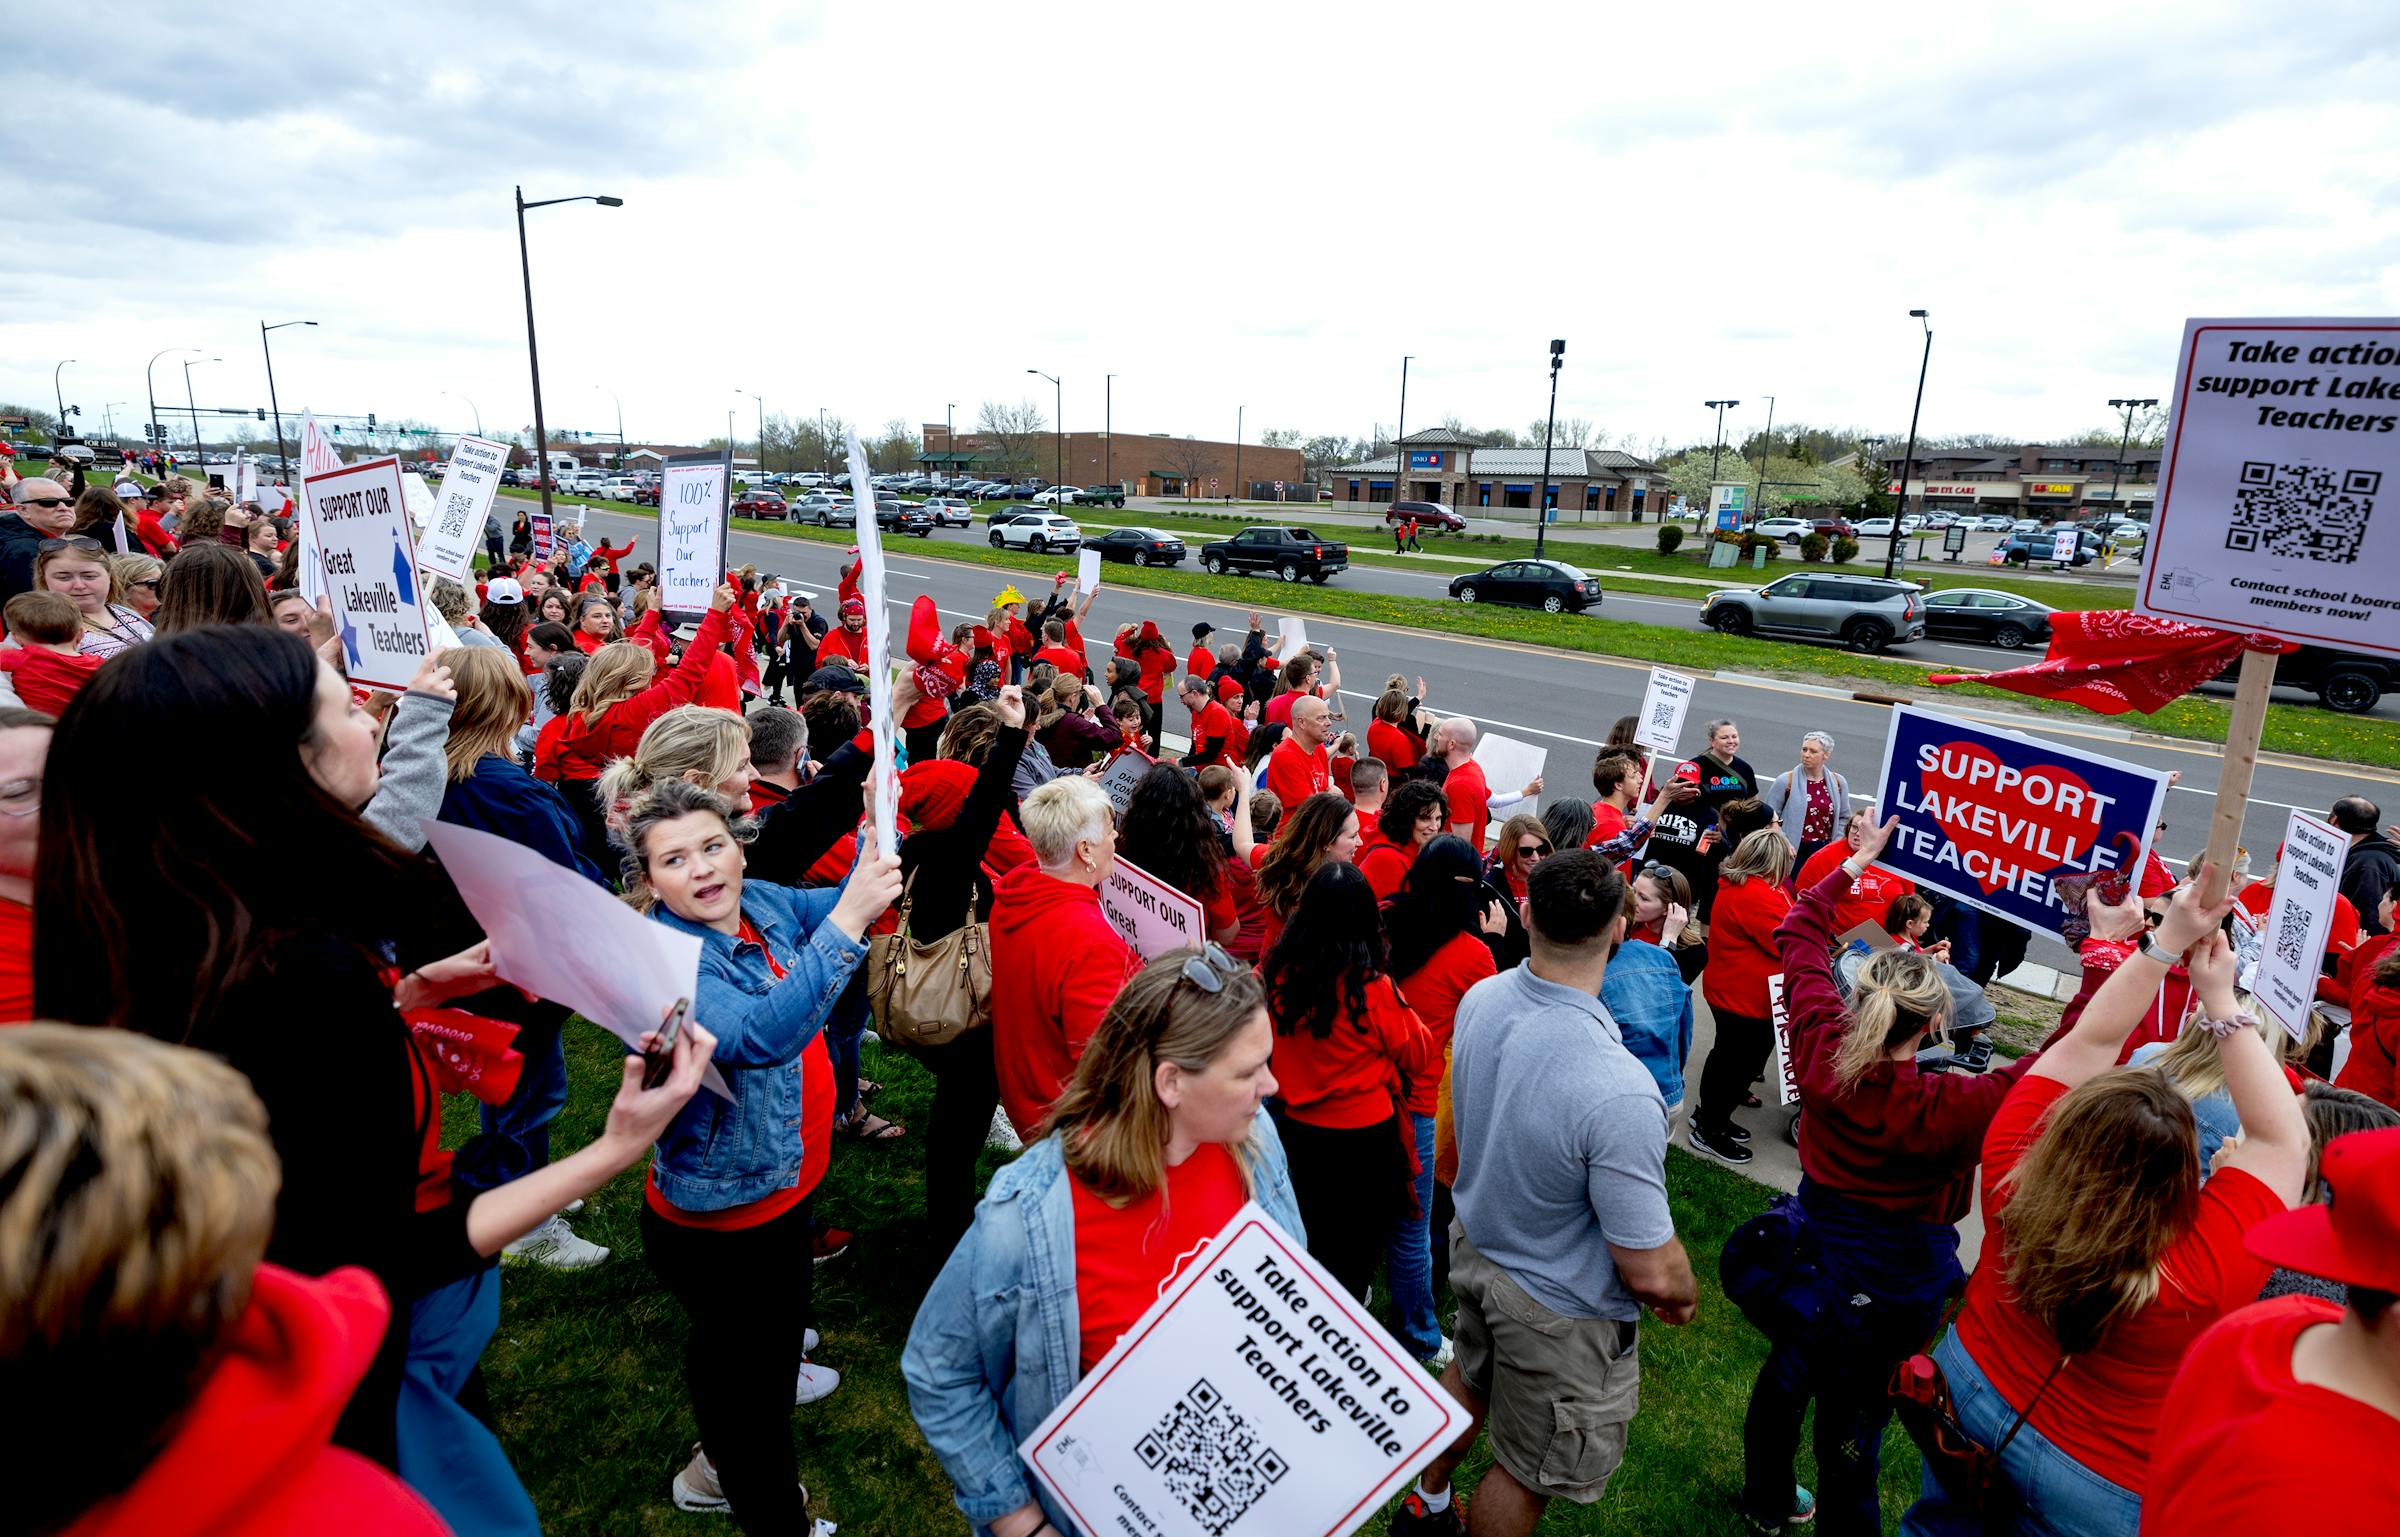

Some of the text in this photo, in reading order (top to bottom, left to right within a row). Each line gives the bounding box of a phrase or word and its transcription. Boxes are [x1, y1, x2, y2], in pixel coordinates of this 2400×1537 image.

[2227, 340, 2400, 365] Take actio
[2196, 375, 2320, 399] support
[2257, 406, 2398, 433] Teachers
[454, 456, 498, 475] support Lakeville
[462, 444, 498, 461] Take action to
[459, 470, 481, 485] Teachers
[1941, 486, 1952, 494] EYE
[2048, 484, 2072, 492] TAN
[319, 486, 392, 522] SUPPORT OUR
[680, 479, 713, 506] 100%
[668, 510, 710, 544] Support
[323, 547, 356, 575] Great
[676, 547, 696, 562] Our
[666, 567, 710, 589] Teachers
[2160, 572, 2174, 590] EML
[2229, 576, 2290, 596] Contact
[2294, 586, 2348, 604] school
[343, 582, 398, 614] Lakeville
[2249, 594, 2371, 622] members now!
[368, 622, 425, 656] Teachers
[1653, 680, 1688, 694] support Lakeville
[1658, 673, 1668, 681] Take
[1660, 689, 1678, 699] Teachers
[1105, 779, 1114, 787] A
[1916, 743, 2116, 825] SUPPORT
[1896, 781, 2120, 874] LAKEVILLE
[2294, 825, 2335, 856] Take action to
[1896, 822, 2070, 914] TEACHER
[2286, 843, 2336, 879] support Lakeville
[2293, 866, 2318, 890] Teachers
[1106, 898, 1138, 939] Great
[1160, 902, 1187, 934] OUR
[1254, 1254, 1410, 1416] Take action to
[1214, 1267, 1402, 1458] support Lakeville
[1235, 1334, 1332, 1435] Teachers
[1056, 1435, 1076, 1455] EML
[1113, 1484, 1157, 1532] Contact
